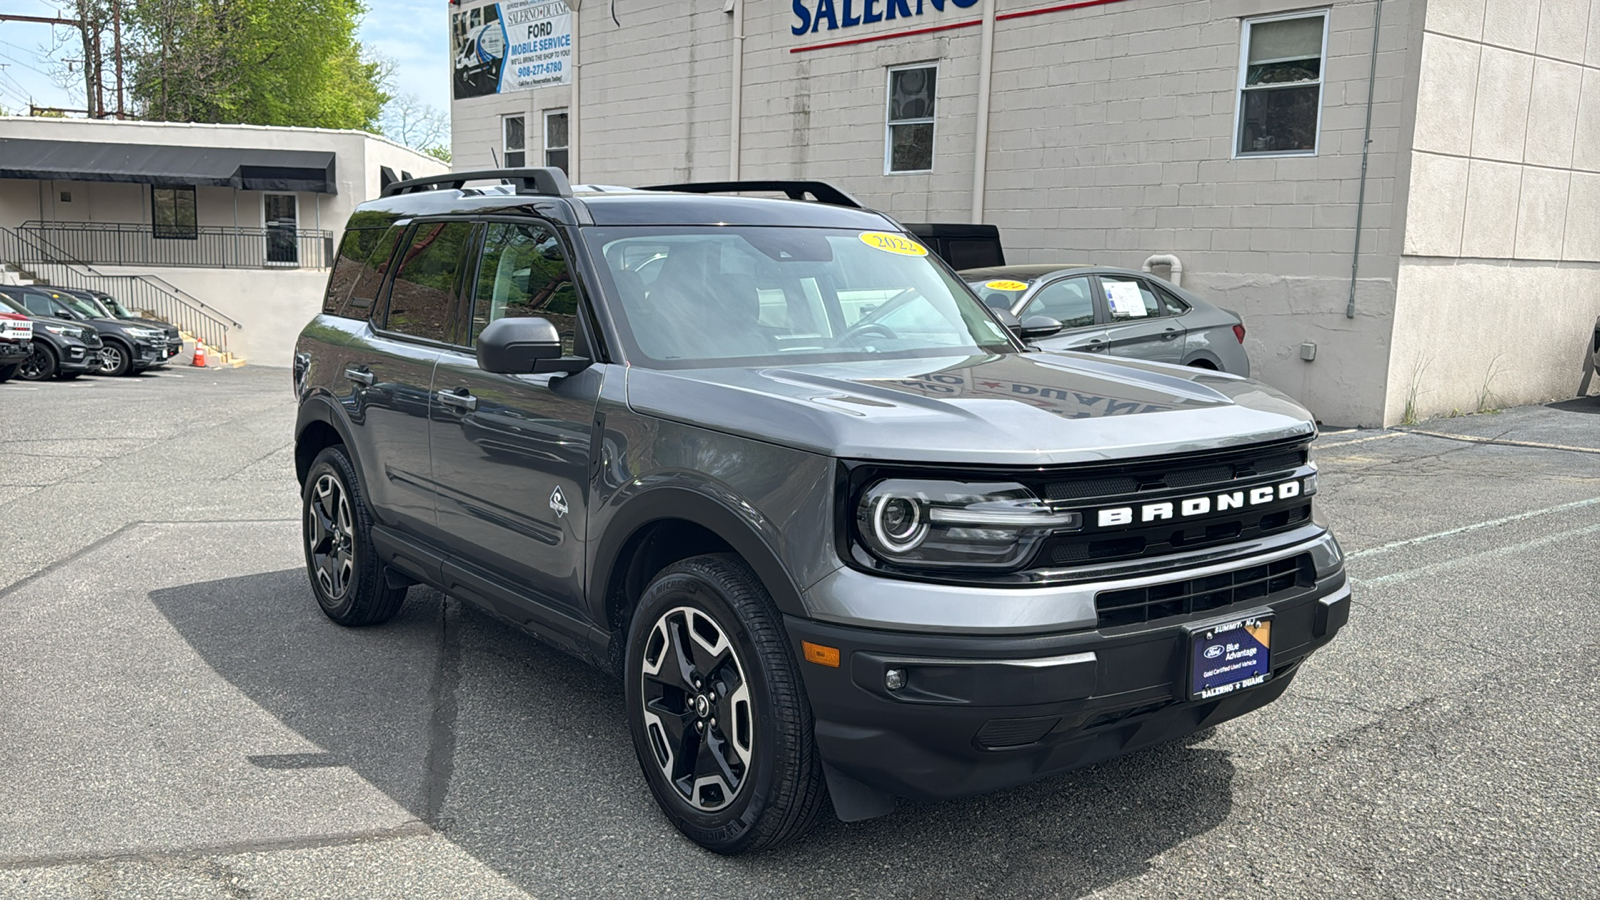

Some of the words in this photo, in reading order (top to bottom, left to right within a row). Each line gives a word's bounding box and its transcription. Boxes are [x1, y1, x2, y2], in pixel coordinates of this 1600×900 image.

[508, 7, 540, 25] SALERNO
[791, 0, 978, 36] SALE
[527, 21, 552, 39] FORD
[511, 41, 538, 56] MOBILE
[539, 34, 570, 51] SERVICE
[523, 56, 534, 64] BRING
[543, 52, 553, 60] SHOP
[518, 61, 562, 77] 908-277-6780
[873, 236, 917, 251] 2022
[1097, 481, 1299, 527] BRONCO
[1206, 646, 1222, 657] Ford
[1225, 647, 1257, 661] Advantage
[1226, 643, 1240, 652] Blue
[1203, 670, 1213, 678] Gold
[1213, 665, 1230, 675] Certified
[1230, 662, 1241, 670] Used
[1242, 659, 1257, 668] Vehicle
[1201, 683, 1234, 698] SALERNO
[1242, 675, 1264, 687] DUANE
